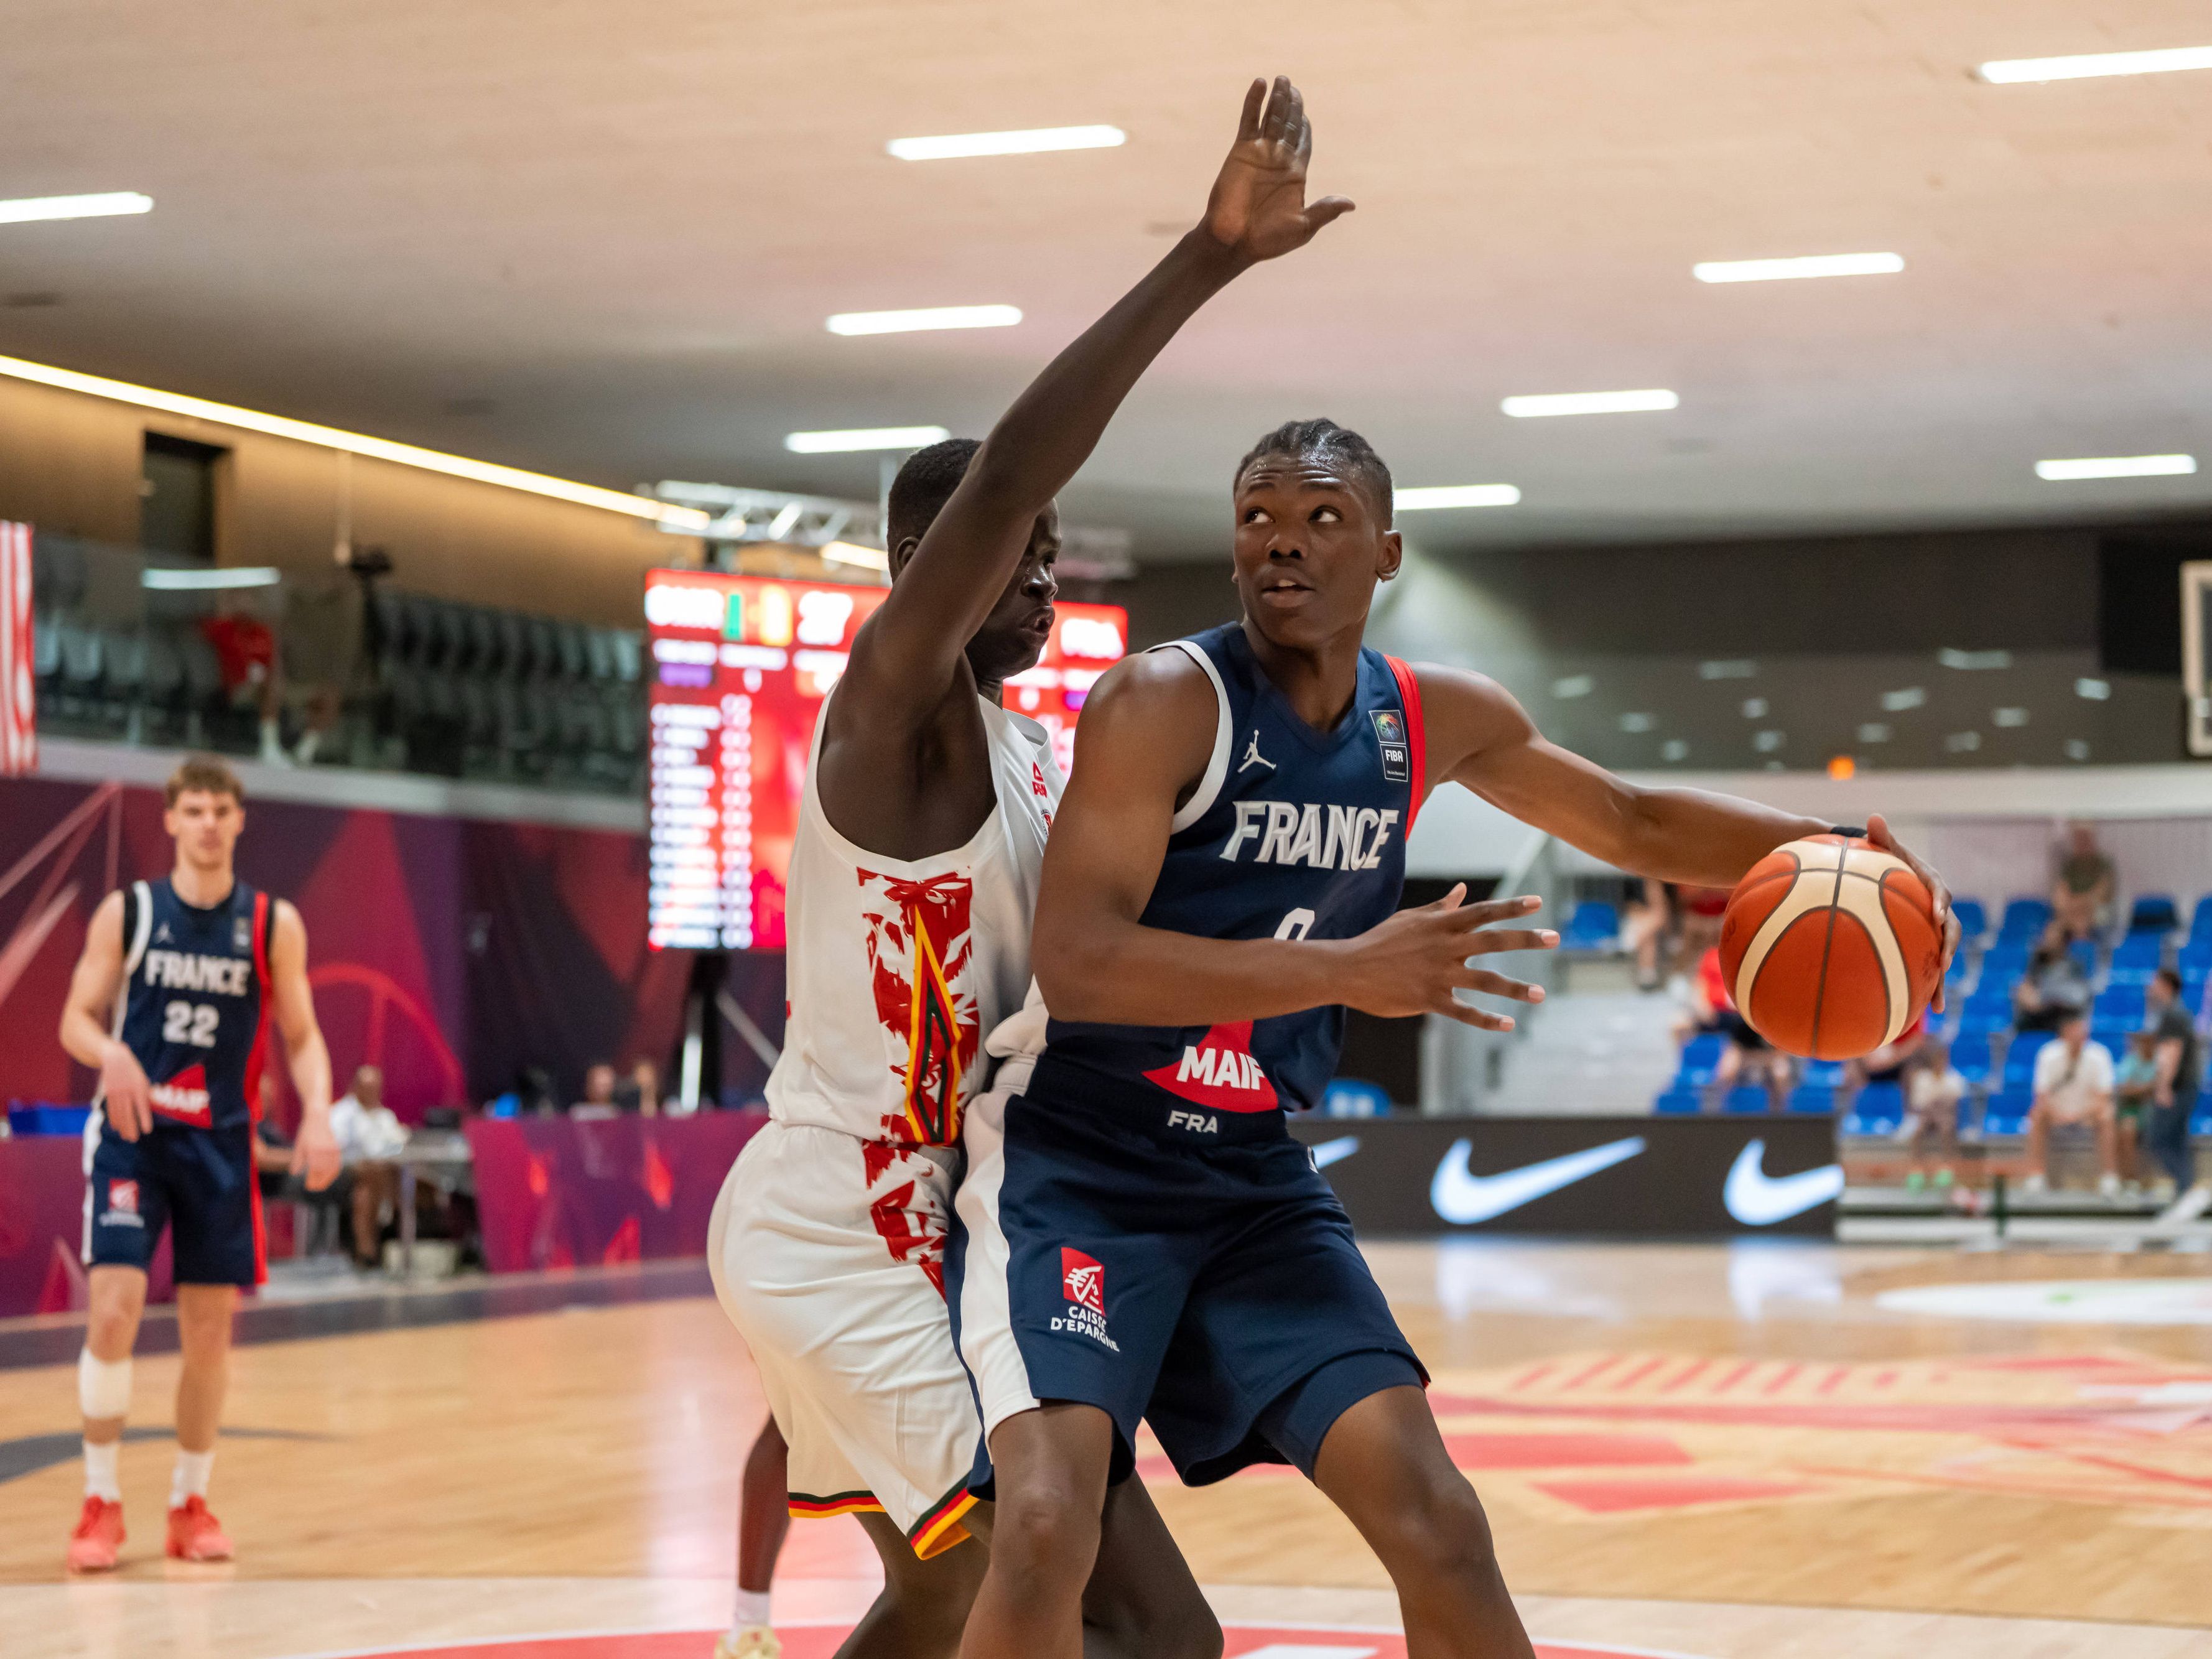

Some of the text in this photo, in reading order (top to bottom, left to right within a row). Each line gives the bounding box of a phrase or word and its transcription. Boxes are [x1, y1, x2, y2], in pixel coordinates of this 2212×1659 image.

[1385, 749, 1404, 763] FIBA
[1219, 801, 1400, 871] FRANCE
[144, 949, 251, 997] FRANCE
[162, 1000, 220, 1049] 22
[1176, 1045, 1265, 1090] MAIF
[1167, 1110, 1218, 1134] FRA
[1050, 1317, 1120, 1352] D'EPARGNE
[1068, 1306, 1107, 1334] CAISSE
